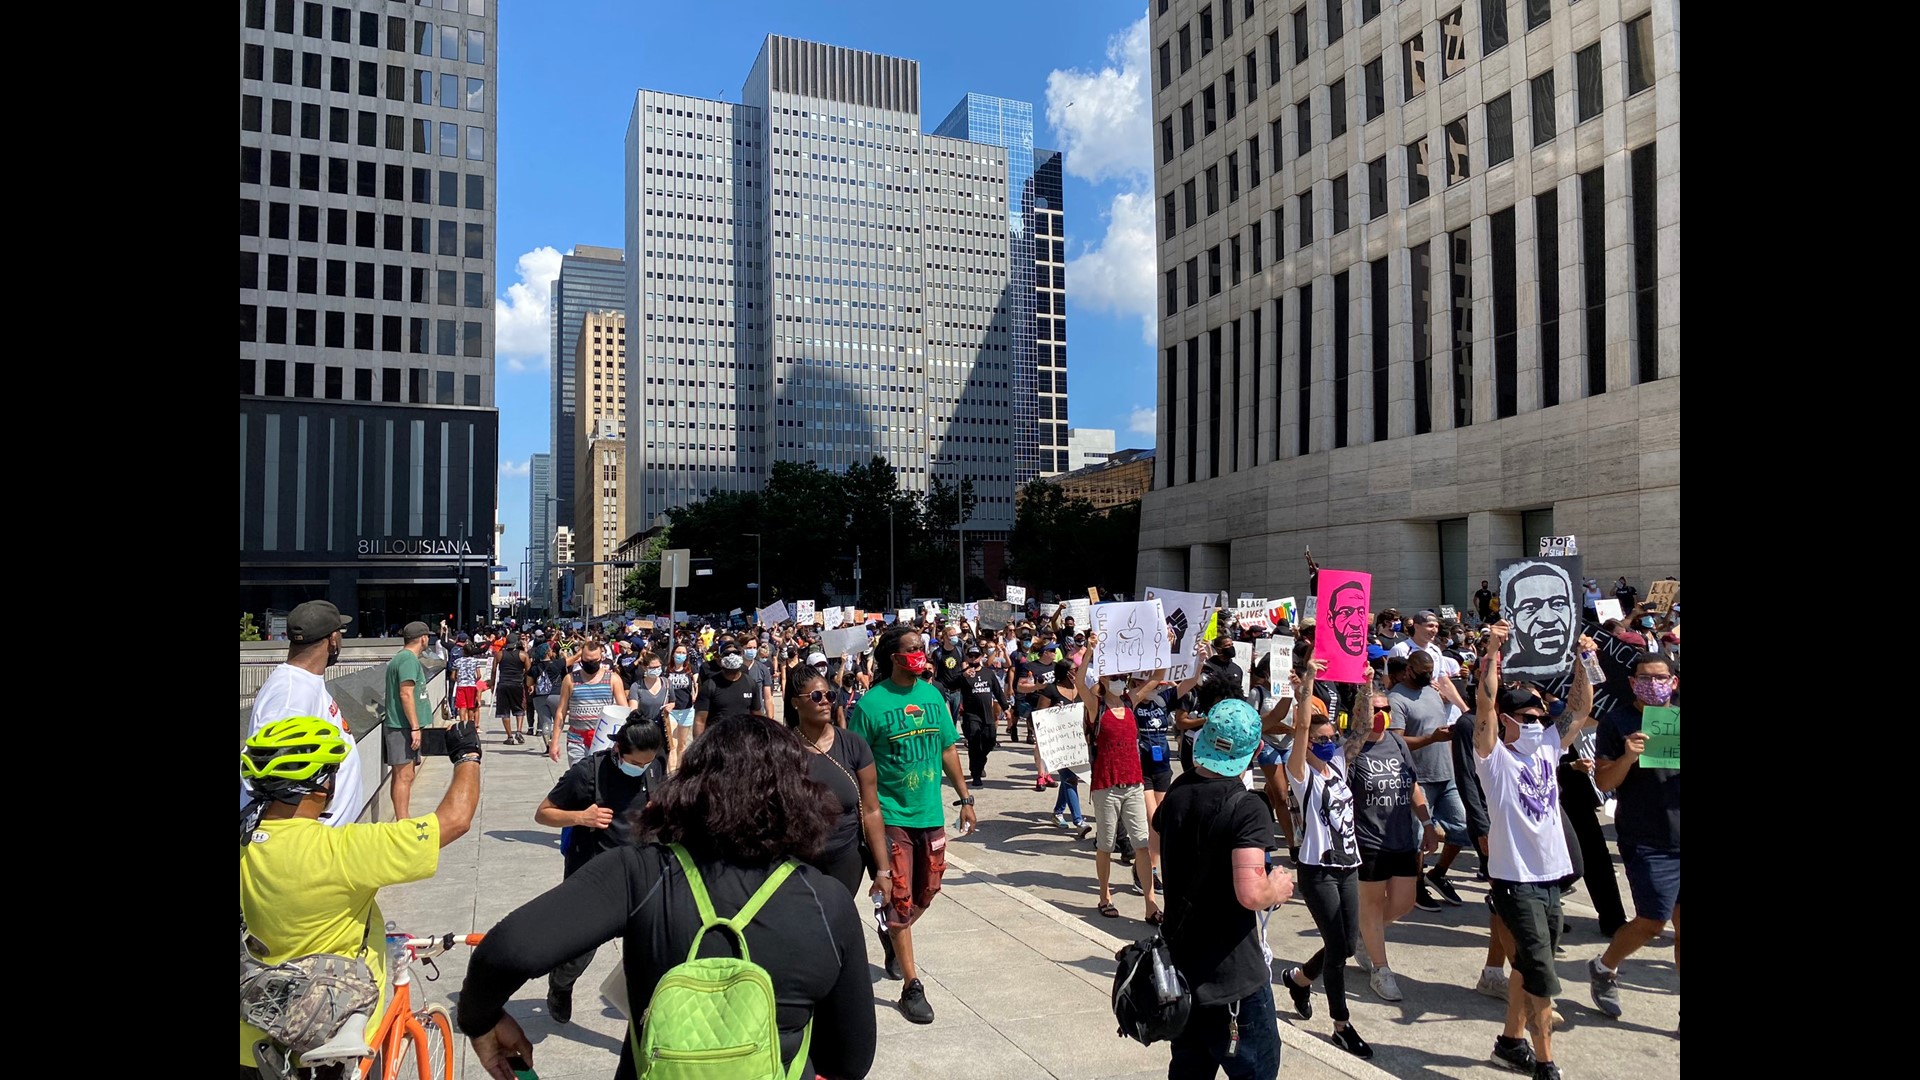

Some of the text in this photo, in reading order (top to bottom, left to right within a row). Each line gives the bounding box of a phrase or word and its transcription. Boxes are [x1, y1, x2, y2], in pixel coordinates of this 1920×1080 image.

[358, 540, 472, 554] 811 LOUISIANA
[1541, 537, 1571, 548] STOP
[1241, 600, 1263, 608] BLACK
[1241, 610, 1262, 619] LIVES
[1096, 606, 1108, 676] GEORGE
[1154, 603, 1162, 669] FLOYD
[1366, 757, 1402, 773] love
[1365, 776, 1413, 793] is greate
[1366, 792, 1412, 807] than hat
